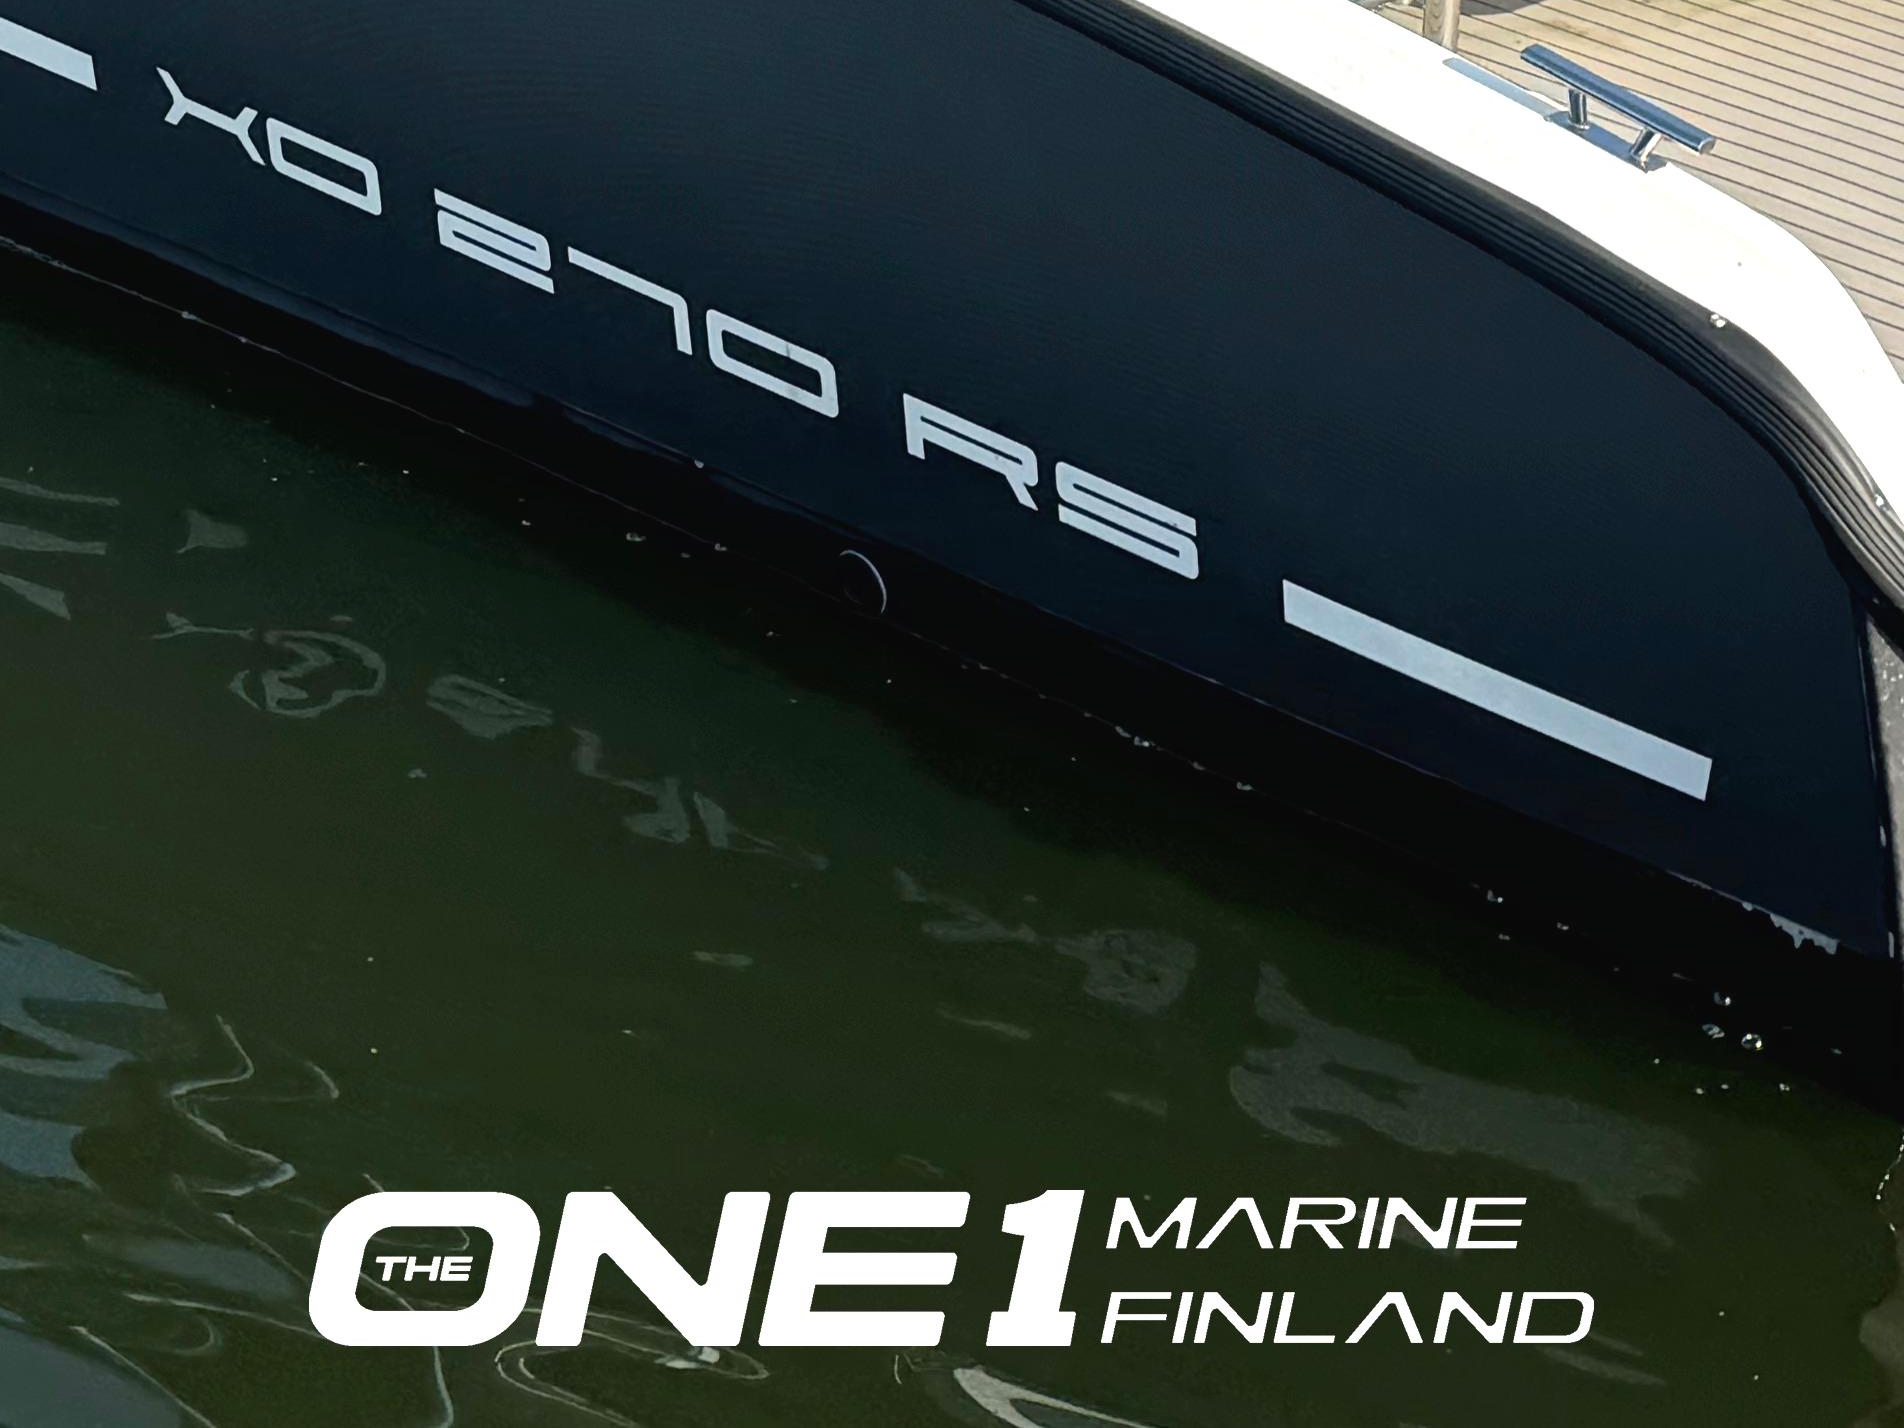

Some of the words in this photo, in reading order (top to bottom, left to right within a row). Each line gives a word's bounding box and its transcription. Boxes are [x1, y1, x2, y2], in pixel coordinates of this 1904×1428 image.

[157, 67, 381, 216] XO
[434, 188, 839, 418] 270
[903, 392, 1199, 580] RS
